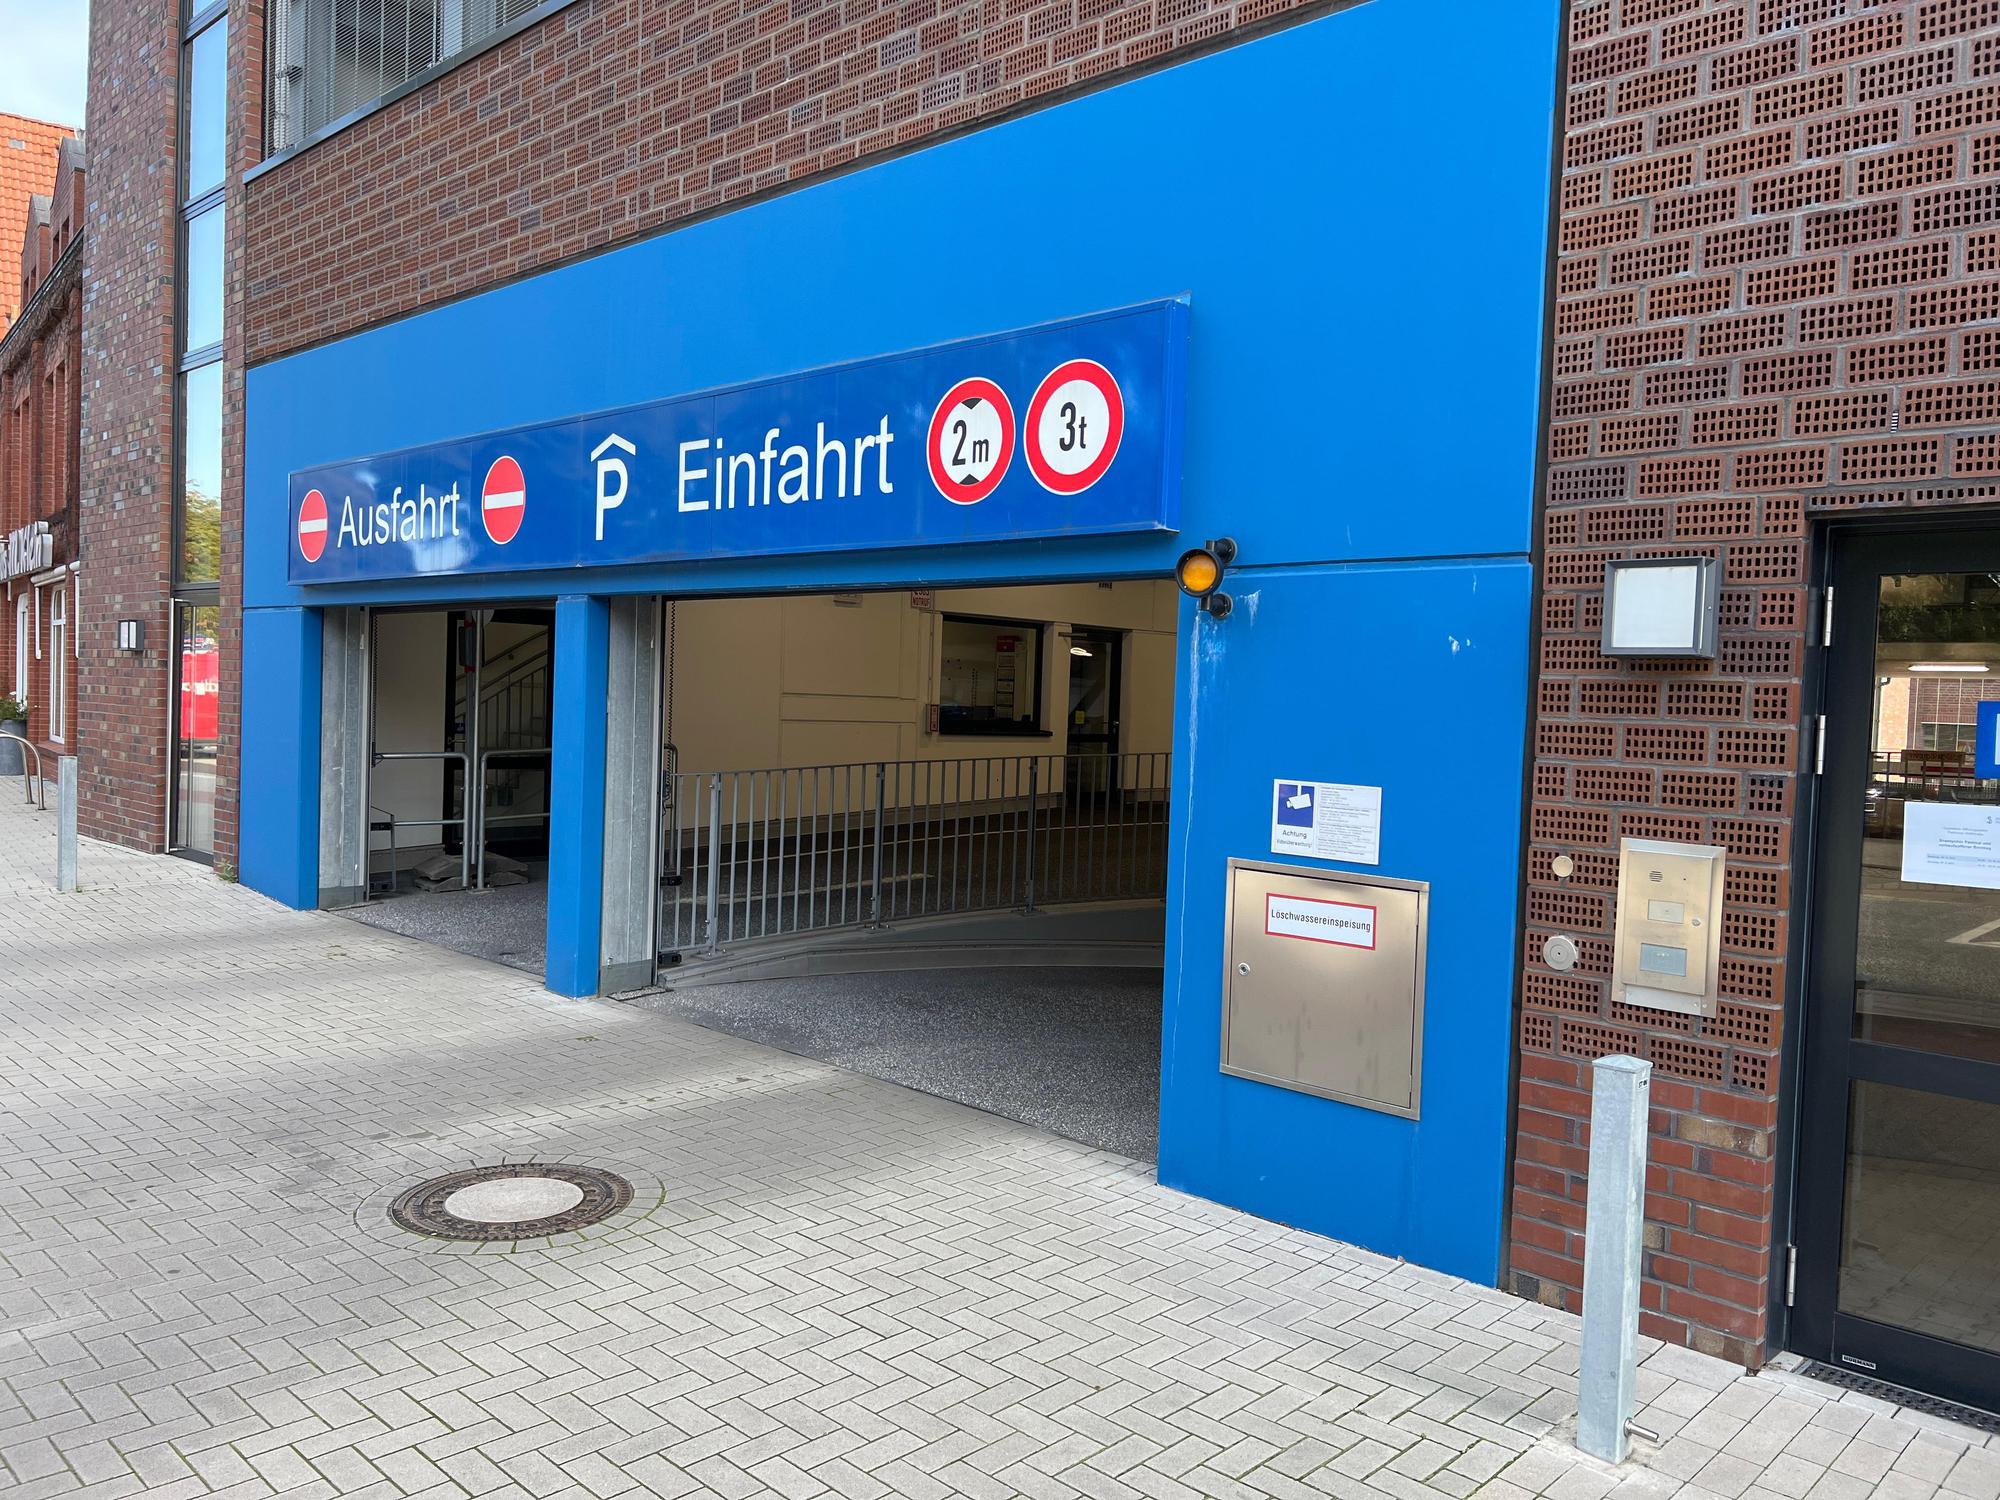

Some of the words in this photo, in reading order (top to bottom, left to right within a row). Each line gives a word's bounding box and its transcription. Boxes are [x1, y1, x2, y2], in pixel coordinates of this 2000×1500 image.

[677, 414, 895, 513] Einfahrt
[336, 480, 461, 548] Ausfahrt
[1282, 829, 1307, 840] Achtung
[1271, 908, 1371, 933] Löschwassereinspeisung
